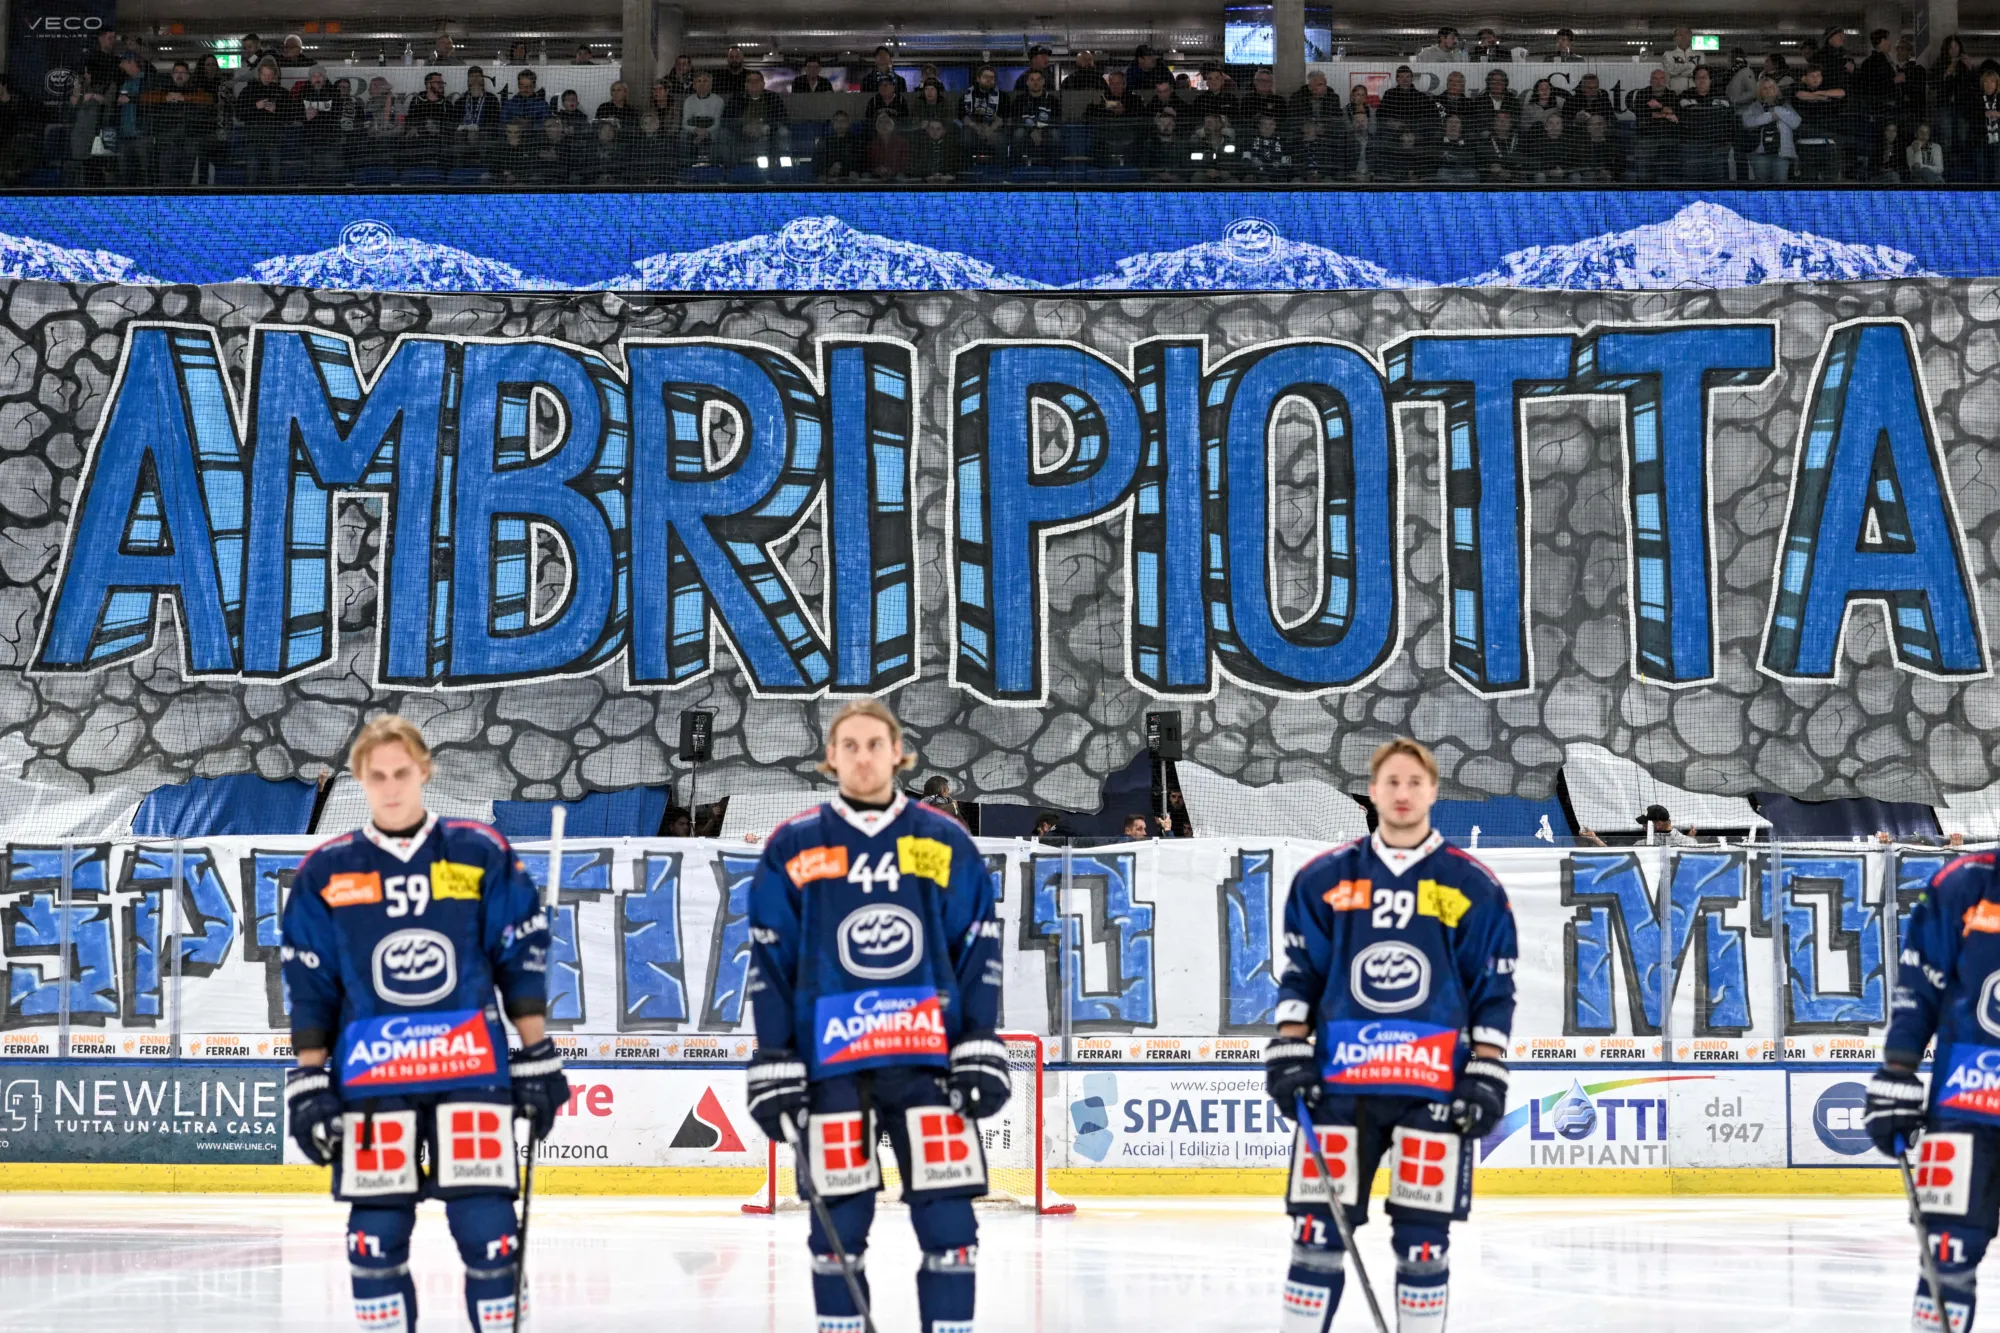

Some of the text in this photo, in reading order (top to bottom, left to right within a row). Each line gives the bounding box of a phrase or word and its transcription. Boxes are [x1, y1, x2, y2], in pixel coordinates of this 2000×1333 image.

[25, 16, 103, 30] VECO
[28, 316, 1994, 708] AMBRI PIOTTA
[848, 852, 901, 894] 44
[384, 874, 430, 918] 59
[1372, 888, 1415, 929] 29
[823, 1008, 946, 1045] ADMIRAL
[4, 1035, 38, 1043] ENNIO
[71, 1035, 105, 1043] ENNIO
[206, 1036, 239, 1046] ENNIO
[615, 1038, 649, 1047] ENNIO
[683, 1039, 718, 1047] ENNIO
[1531, 1039, 1565, 1048] ENNIO
[1600, 1039, 1634, 1048] ENNIO
[1830, 1039, 1864, 1048] ENNIO
[4, 1045, 49, 1054] FERRARI
[71, 1045, 116, 1054] FERRARI
[348, 1031, 488, 1066] ADMIRAL
[1077, 1040, 1111, 1049] ENNIO
[1146, 1040, 1180, 1049] ENNIO
[1215, 1040, 1249, 1049] ENNIO
[1693, 1040, 1728, 1049] ENNIO
[206, 1046, 249, 1056] FERRARI
[615, 1048, 660, 1058] FERRARI
[683, 1048, 728, 1058] FERRARI
[1077, 1050, 1122, 1059] FERRARI
[1146, 1050, 1191, 1059] FERRARI
[1215, 1050, 1260, 1059] FERRARI
[1531, 1049, 1576, 1059] FERRARI
[1600, 1049, 1645, 1058] FERRARI
[1693, 1051, 1739, 1060] FERRARI
[1830, 1050, 1875, 1059] FERRARI
[1332, 1042, 1450, 1073] ADMIRAL
[371, 1057, 481, 1079] MENDRISIO
[55, 1080, 277, 1117] NEWLINE
[1704, 1097, 1742, 1118] dal
[1123, 1098, 1291, 1134] SPAETER
[1530, 1098, 1667, 1141] LOTTI
[55, 1120, 115, 1133] TUTTA
[227, 1121, 277, 1134] CASA
[1706, 1123, 1765, 1144] 1947
[196, 1142, 277, 1151] WWW.NEW-LINE.CH
[1122, 1142, 1165, 1156] Acciai
[1180, 1142, 1230, 1156] Edilizia
[1530, 1145, 1668, 1165] IMPIANTI
[453, 1165, 485, 1178] Studio
[1396, 1187, 1431, 1201] Studio
